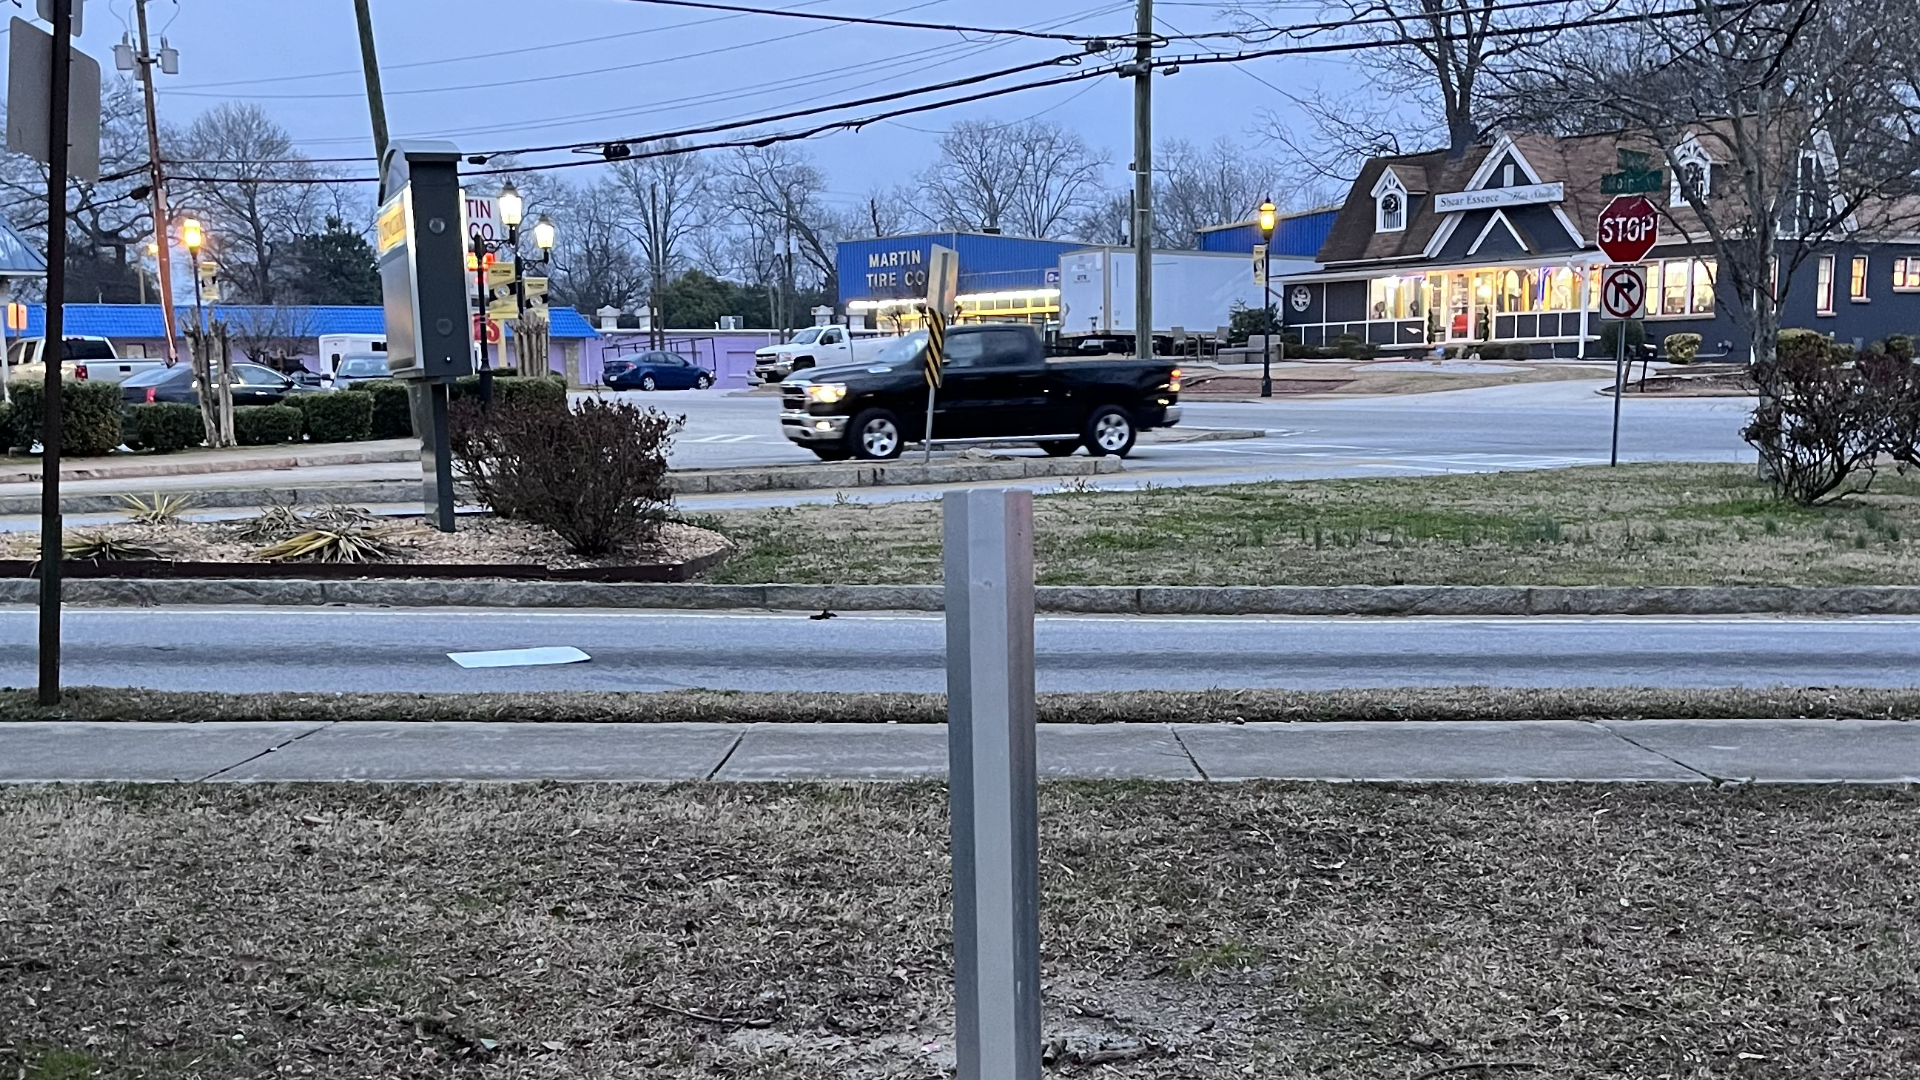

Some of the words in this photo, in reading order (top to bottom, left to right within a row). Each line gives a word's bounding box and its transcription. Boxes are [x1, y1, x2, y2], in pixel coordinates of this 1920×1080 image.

[1440, 196, 1464, 208] Shear
[1466, 193, 1500, 204] Essence
[469, 222, 494, 241] CO
[1601, 216, 1655, 243] STOP
[868, 249, 921, 268] MARTIN
[865, 271, 897, 288] TIRE
[904, 269, 926, 286] CO
